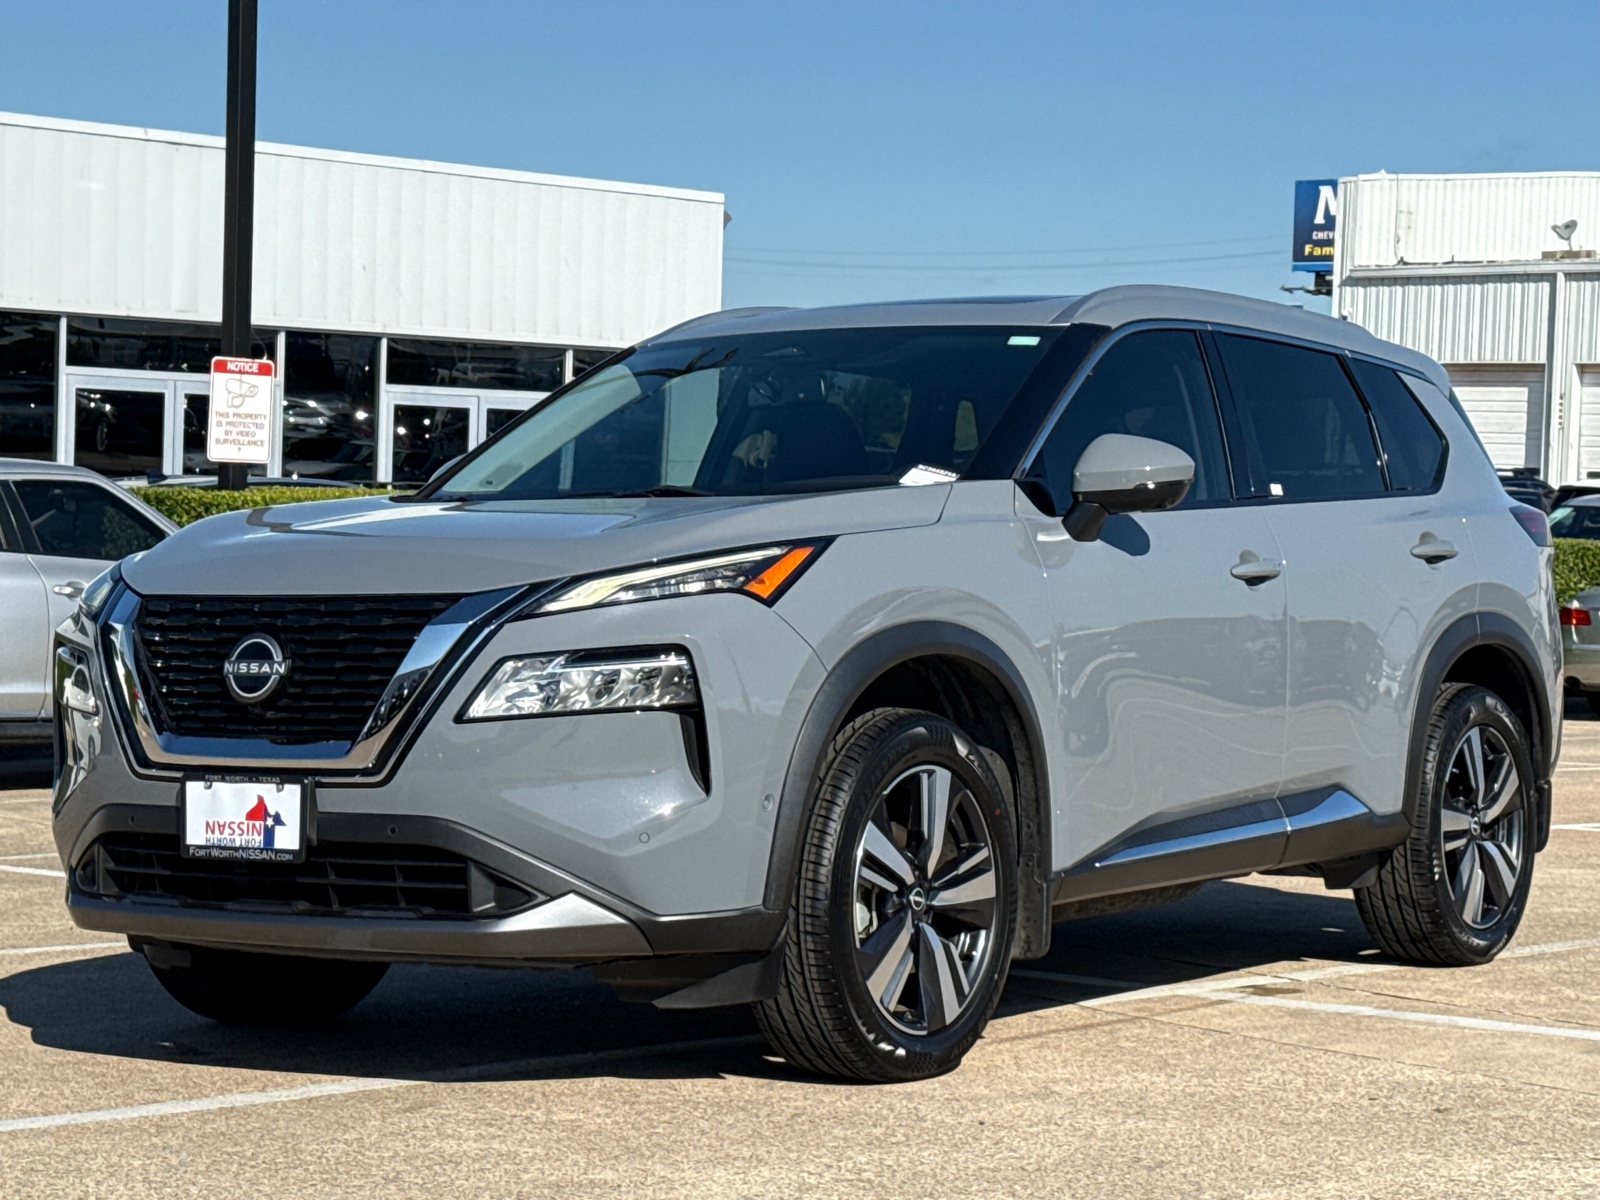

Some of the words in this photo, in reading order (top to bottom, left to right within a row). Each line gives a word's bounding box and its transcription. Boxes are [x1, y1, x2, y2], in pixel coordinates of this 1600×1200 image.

[227, 361, 259, 373] NOTICE
[215, 411, 230, 419] THIS
[232, 412, 267, 420] PROPERTY
[216, 420, 223, 428] IS
[225, 421, 265, 430] PROTECTED
[224, 429, 233, 437] BY
[236, 430, 257, 438] VIDEO
[215, 438, 265, 447] SURVEILLANCE
[224, 661, 286, 674] NISSAN
[205, 820, 263, 837] NISSAN
[205, 836, 237, 848] WORTH
[239, 837, 262, 848] FORT
